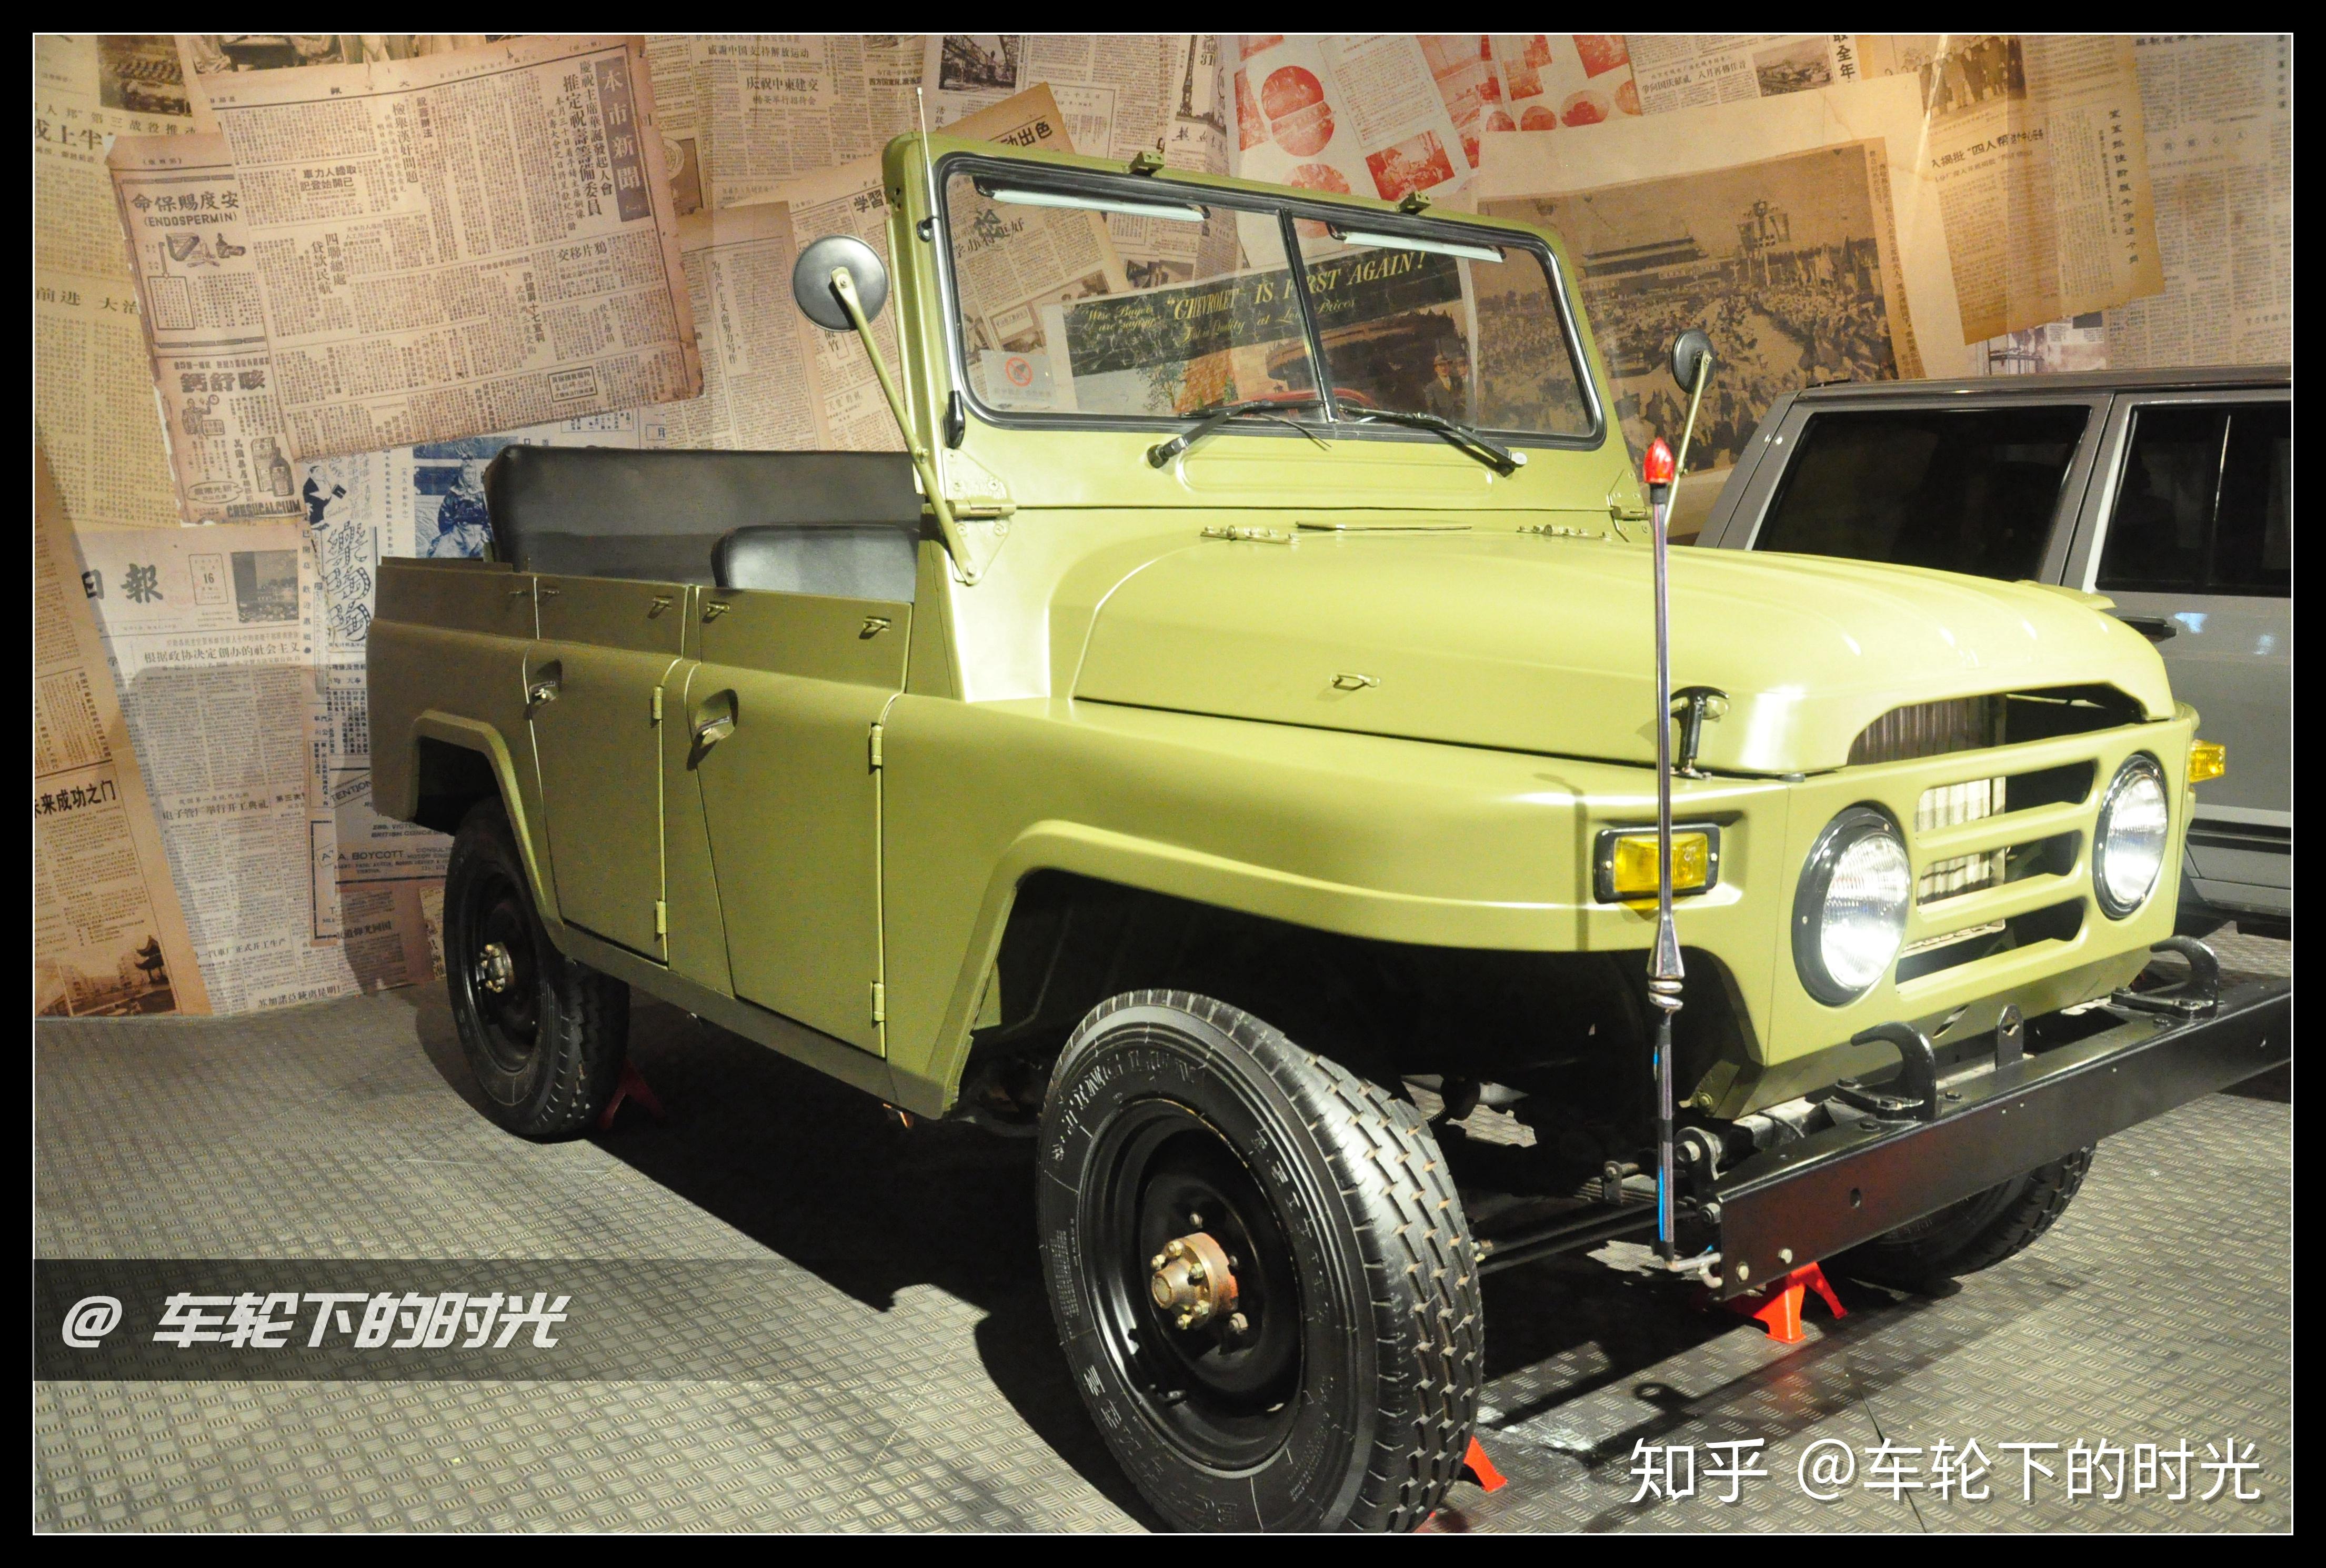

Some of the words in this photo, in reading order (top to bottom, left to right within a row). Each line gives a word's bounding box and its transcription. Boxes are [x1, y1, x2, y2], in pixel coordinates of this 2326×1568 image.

[144, 212, 237, 227] (ENDOSPERMIN)
[1254, 280, 1274, 304] IS
[1284, 268, 1341, 299] FRST
[352, 850, 404, 860] BOYCOTT
